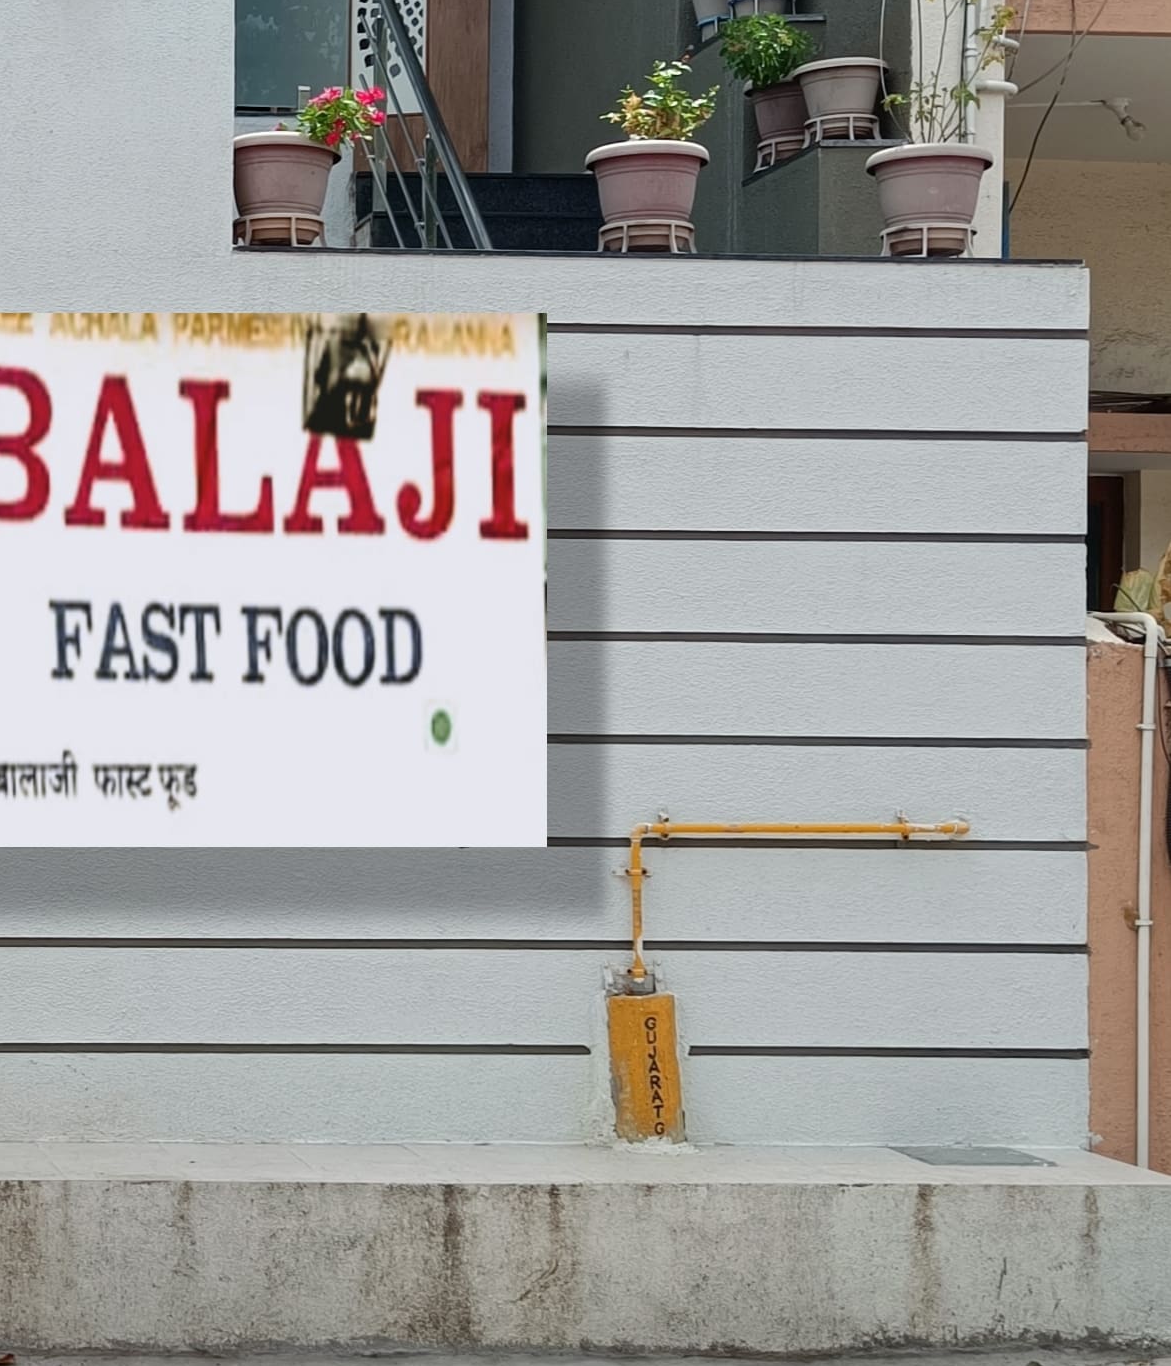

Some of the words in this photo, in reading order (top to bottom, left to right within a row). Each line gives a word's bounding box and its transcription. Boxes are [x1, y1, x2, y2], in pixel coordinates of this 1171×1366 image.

[49, 600, 221, 683] FAST
[240, 606, 422, 688] FOOD
[93, 764, 152, 798] फास्ट
[157, 764, 197, 810] फूड
[644, 1016, 665, 1119] GUJARAT
